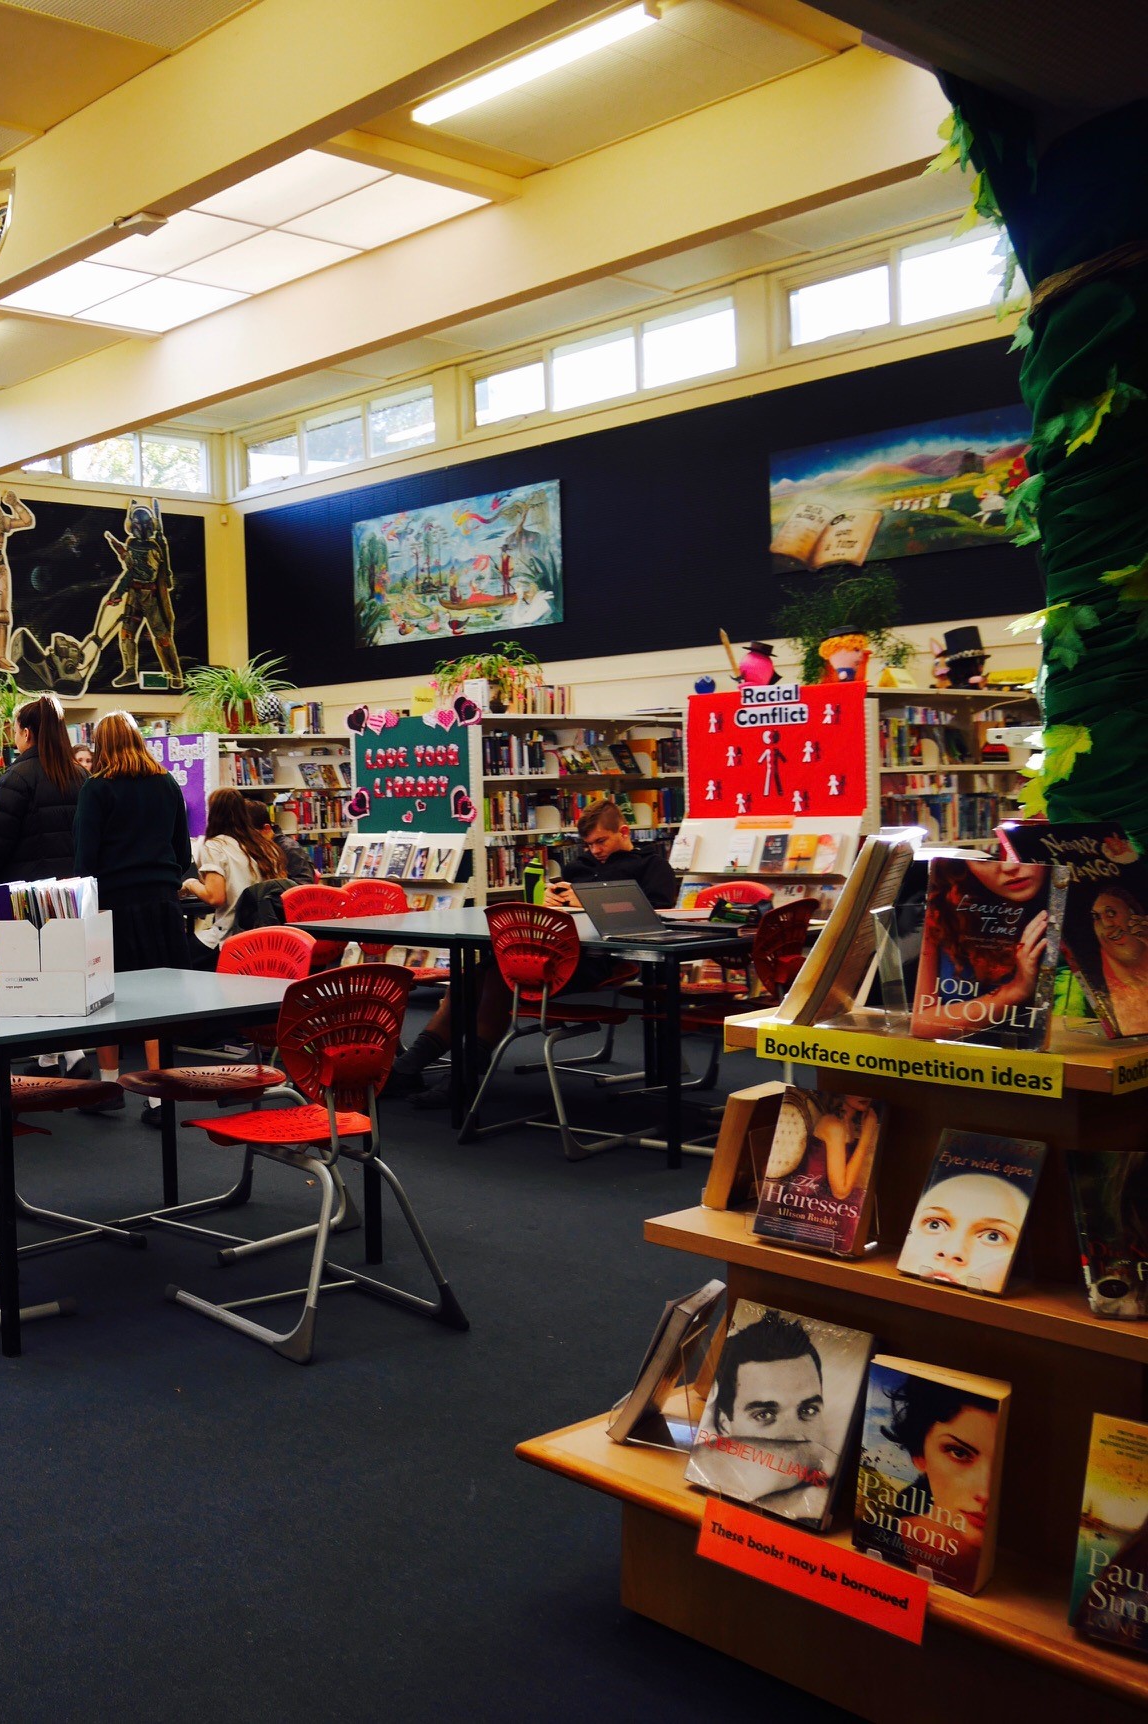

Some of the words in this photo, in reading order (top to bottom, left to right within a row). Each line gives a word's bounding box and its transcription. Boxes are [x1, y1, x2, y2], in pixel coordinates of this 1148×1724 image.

[742, 684, 799, 704] Racial
[736, 706, 807, 725] Conflict
[364, 745, 409, 770] LOVE
[413, 743, 460, 768] YOUR
[373, 775, 450, 799] LIBRARY
[956, 894, 1024, 923] Leaving
[980, 916, 1018, 937] Time
[932, 977, 980, 998] JODI
[917, 994, 1043, 1029] PICOULT
[764, 1037, 850, 1065] Bookface
[856, 1054, 984, 1083] competition
[992, 1065, 1053, 1091] ideas
[938, 1151, 968, 1168] Eyes
[970, 1157, 1000, 1172] wide
[1003, 1164, 1034, 1178] open
[791, 1173, 822, 1192] The
[765, 1181, 859, 1219] Heiresses
[777, 1207, 806, 1220] Allison
[807, 1212, 839, 1227] Rushby
[862, 1471, 967, 1533] Paullina
[862, 1499, 959, 1556] Simons
[711, 1521, 744, 1544] These
[747, 1534, 785, 1560] books
[787, 1552, 818, 1575] may
[821, 1564, 838, 1582] be
[841, 1572, 910, 1611] borrowed
[1086, 1547, 1148, 1595] Pau
[1088, 1579, 1148, 1624] Sim
